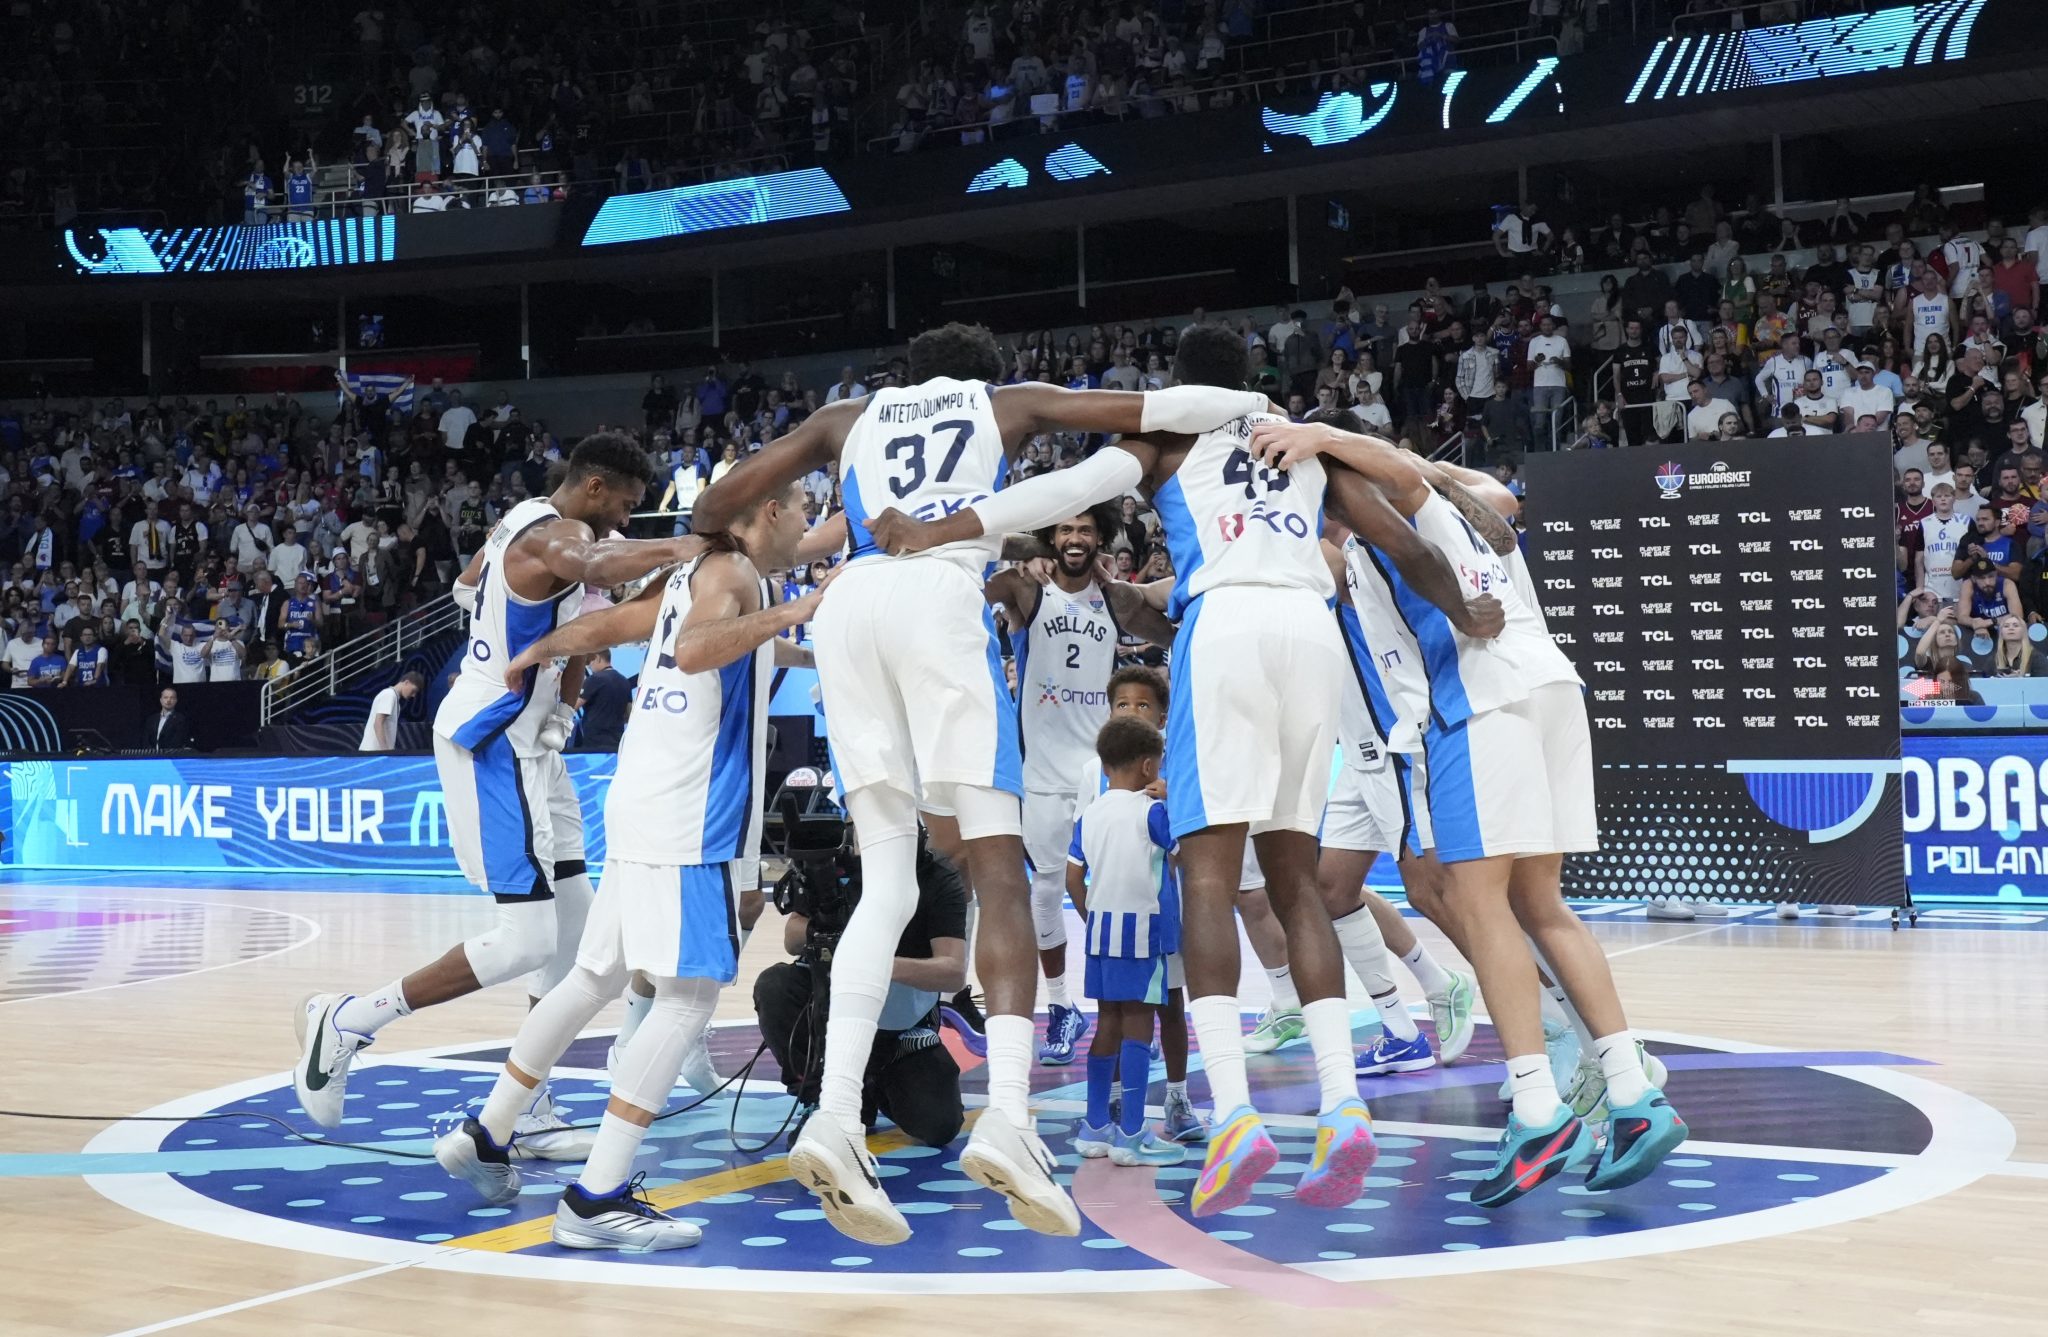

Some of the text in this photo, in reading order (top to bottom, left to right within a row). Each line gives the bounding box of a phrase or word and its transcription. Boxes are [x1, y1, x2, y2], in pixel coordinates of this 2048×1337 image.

[294, 85, 333, 104] 312
[295, 185, 305, 193] 23
[1917, 305, 1943, 313] FINLAND
[1925, 315, 1936, 325] 23
[1634, 368, 1640, 377] 9
[1786, 370, 1795, 380] 11
[1826, 376, 1833, 387] 9
[885, 419, 975, 500] 37
[1688, 471, 1752, 485] EUROBASKET
[1738, 512, 1771, 523] TCL
[1841, 507, 1875, 518] TCL
[1543, 521, 1574, 532] TCL
[1639, 517, 1670, 528] TCL
[1938, 527, 1946, 539] 6
[1689, 544, 1721, 555] TCL
[1790, 539, 1823, 550] TCL
[1927, 541, 1959, 553] FINLAN
[1591, 548, 1622, 559] TCL
[1740, 572, 1772, 582] TCL
[1842, 568, 1876, 579] TCL
[1544, 578, 1575, 590] TCL
[1640, 575, 1672, 586] TCL
[1690, 601, 1723, 612] TCL
[1791, 598, 1825, 609] TCL
[1593, 604, 1624, 615] TCL
[1043, 615, 1107, 642] HELLAS
[1741, 628, 1774, 639] TCL
[1844, 625, 1878, 636] TCL
[1642, 631, 1673, 641] TCL
[1066, 643, 1080, 669] 2
[1594, 661, 1625, 672] TCL
[1692, 659, 1724, 670] TCL
[1793, 657, 1826, 668] TCL
[82, 670, 93, 681] 23
[1643, 689, 1675, 700] TCL
[1743, 688, 1775, 699] TCL
[1846, 686, 1880, 697] TCL
[1594, 717, 1626, 729] TCL
[1693, 717, 1725, 728] TCL
[1794, 716, 1828, 727] TCL
[1902, 755, 2048, 832] OBA
[101, 783, 453, 848] MAKE YOUR M
